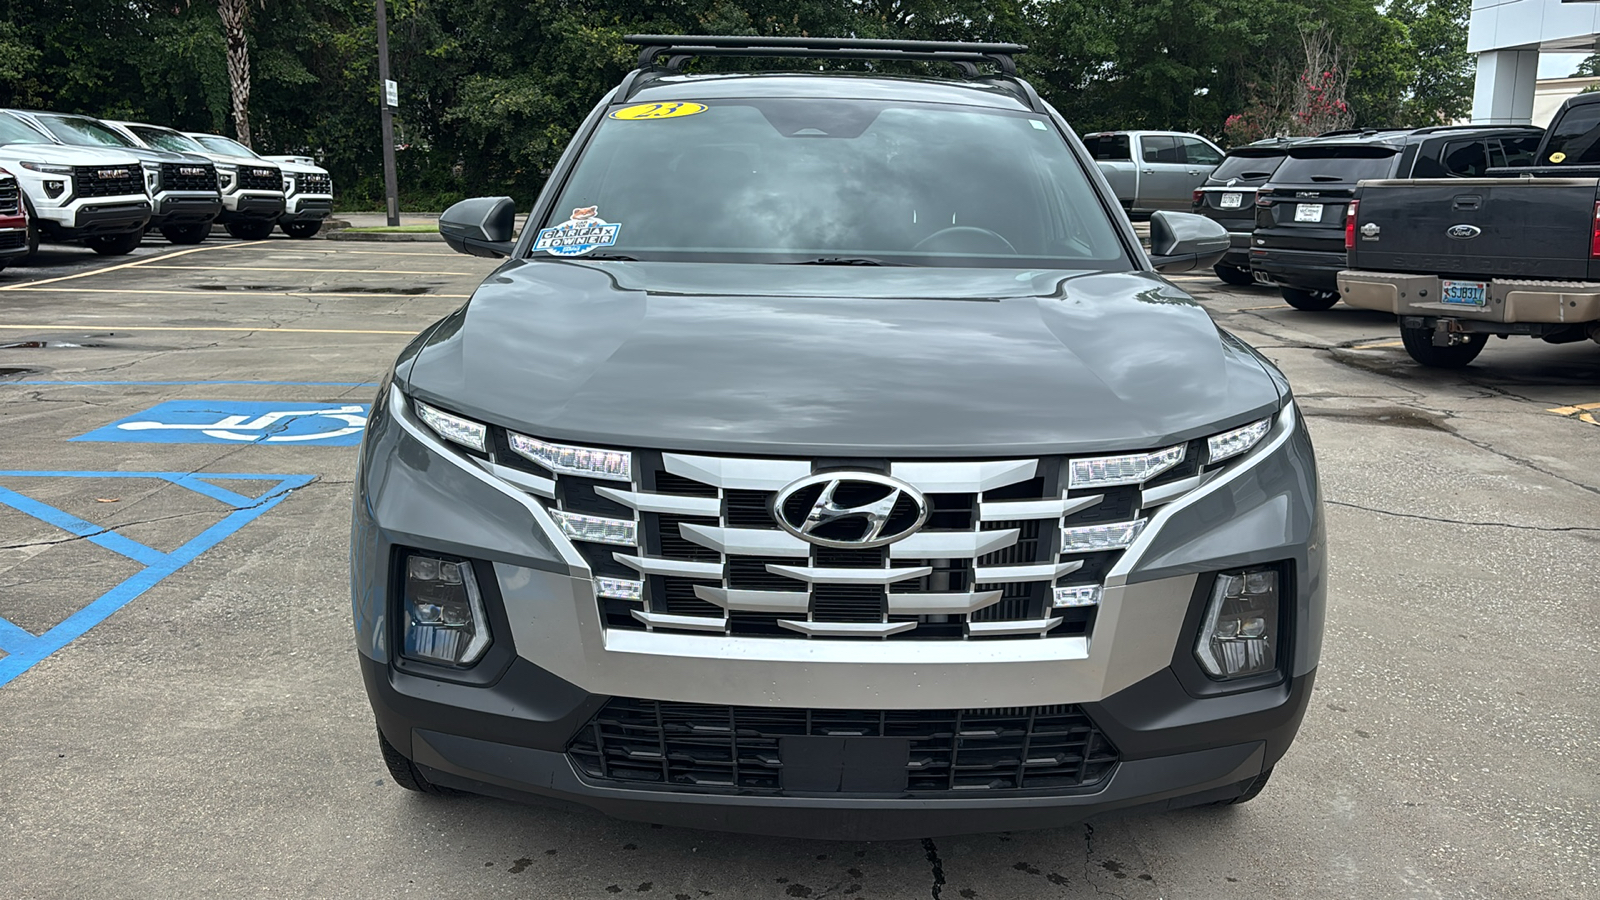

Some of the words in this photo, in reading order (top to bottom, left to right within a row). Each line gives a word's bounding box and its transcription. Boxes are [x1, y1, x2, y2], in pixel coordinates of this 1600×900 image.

[633, 102, 684, 118] 23
[543, 228, 613, 239] CARFAX
[1453, 227, 1472, 236] Ford
[553, 235, 611, 247] OWNER
[1393, 257, 1463, 270] SUPER
